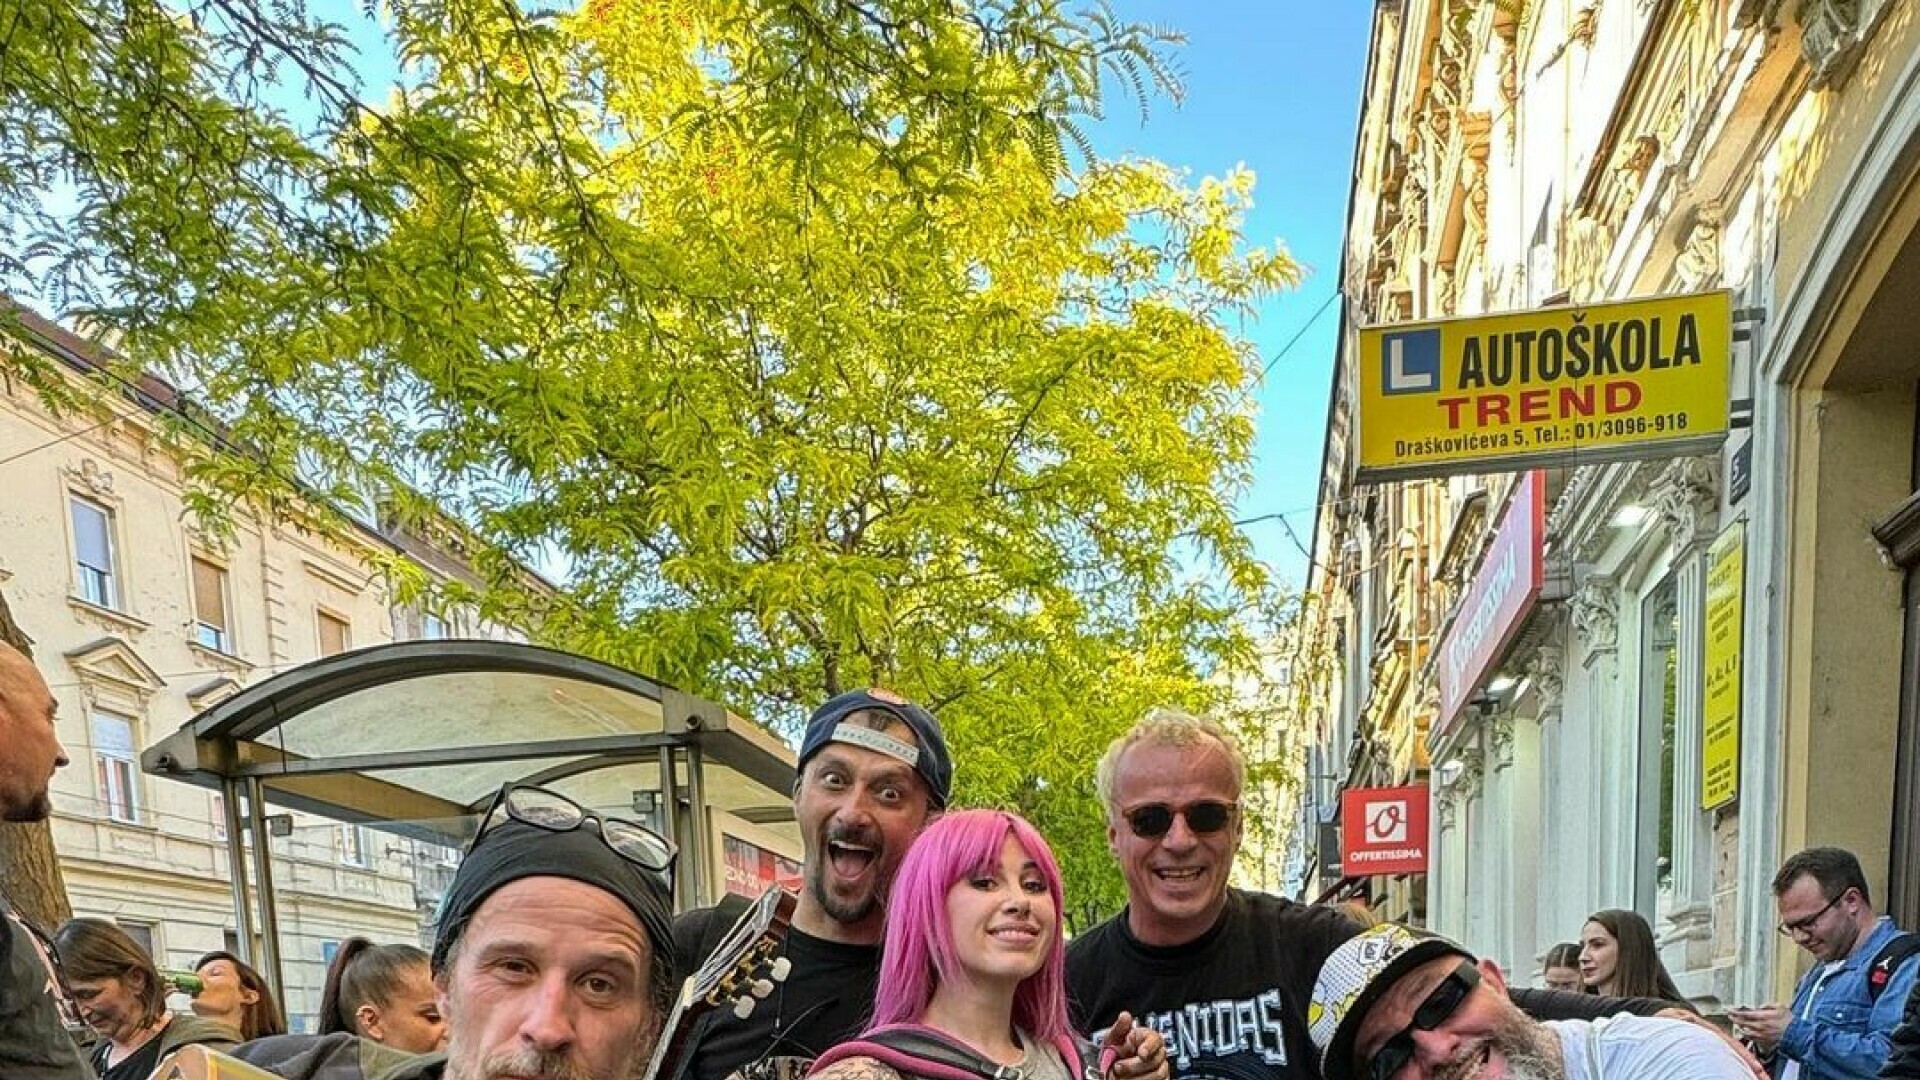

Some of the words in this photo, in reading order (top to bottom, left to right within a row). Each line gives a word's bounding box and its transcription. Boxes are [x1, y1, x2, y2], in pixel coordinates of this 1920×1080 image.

[1458, 313, 1701, 390] AUTOŠKOLA
[1438, 380, 1643, 430] TREND
[1395, 431, 1508, 457] Draškovićeva
[1534, 424, 1570, 443] Tel.:
[1575, 412, 1687, 440] 01/3096-918
[1350, 848, 1422, 863] OFFERTISSIMA
